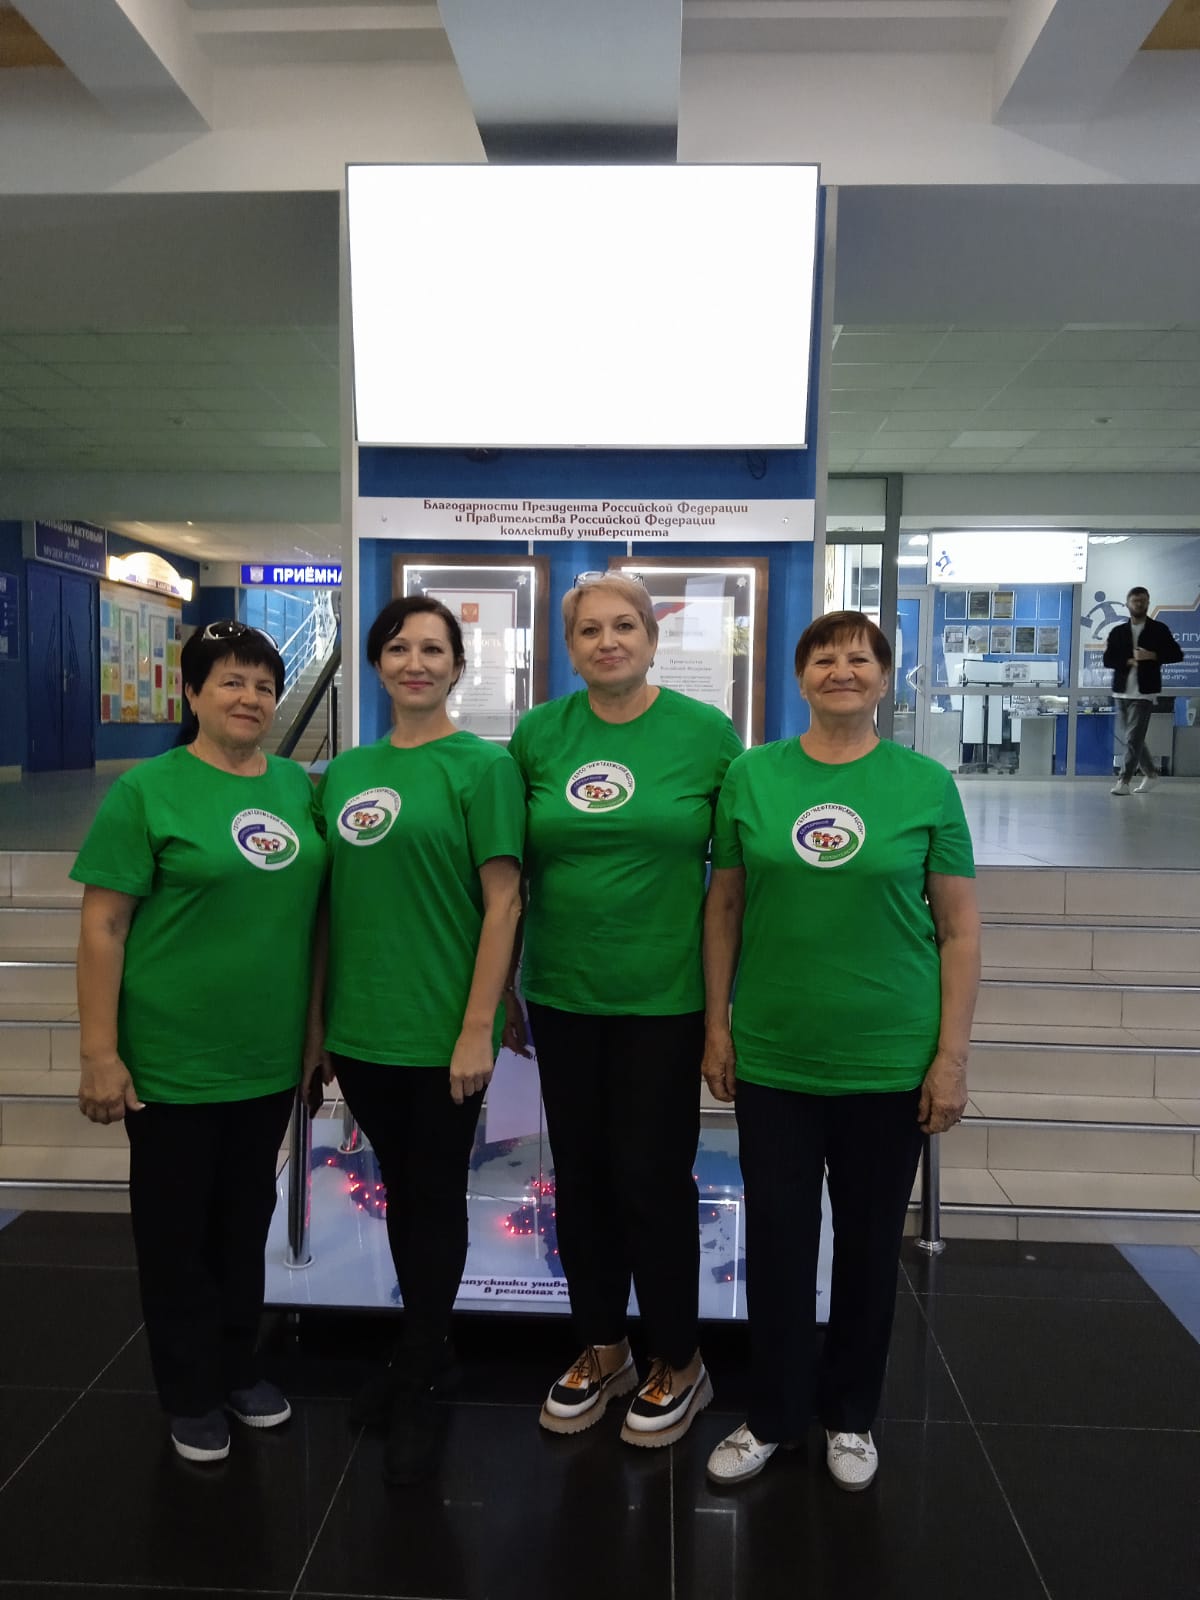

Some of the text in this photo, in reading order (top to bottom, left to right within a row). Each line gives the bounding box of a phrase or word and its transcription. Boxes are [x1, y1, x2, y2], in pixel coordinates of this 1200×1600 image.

[423, 499, 748, 515] Благодарности Президента Российской Федерации
[455, 512, 715, 528] и Правительства Российской Федерации
[500, 525, 668, 540] коллективу университета
[531, 1281, 569, 1289] униве
